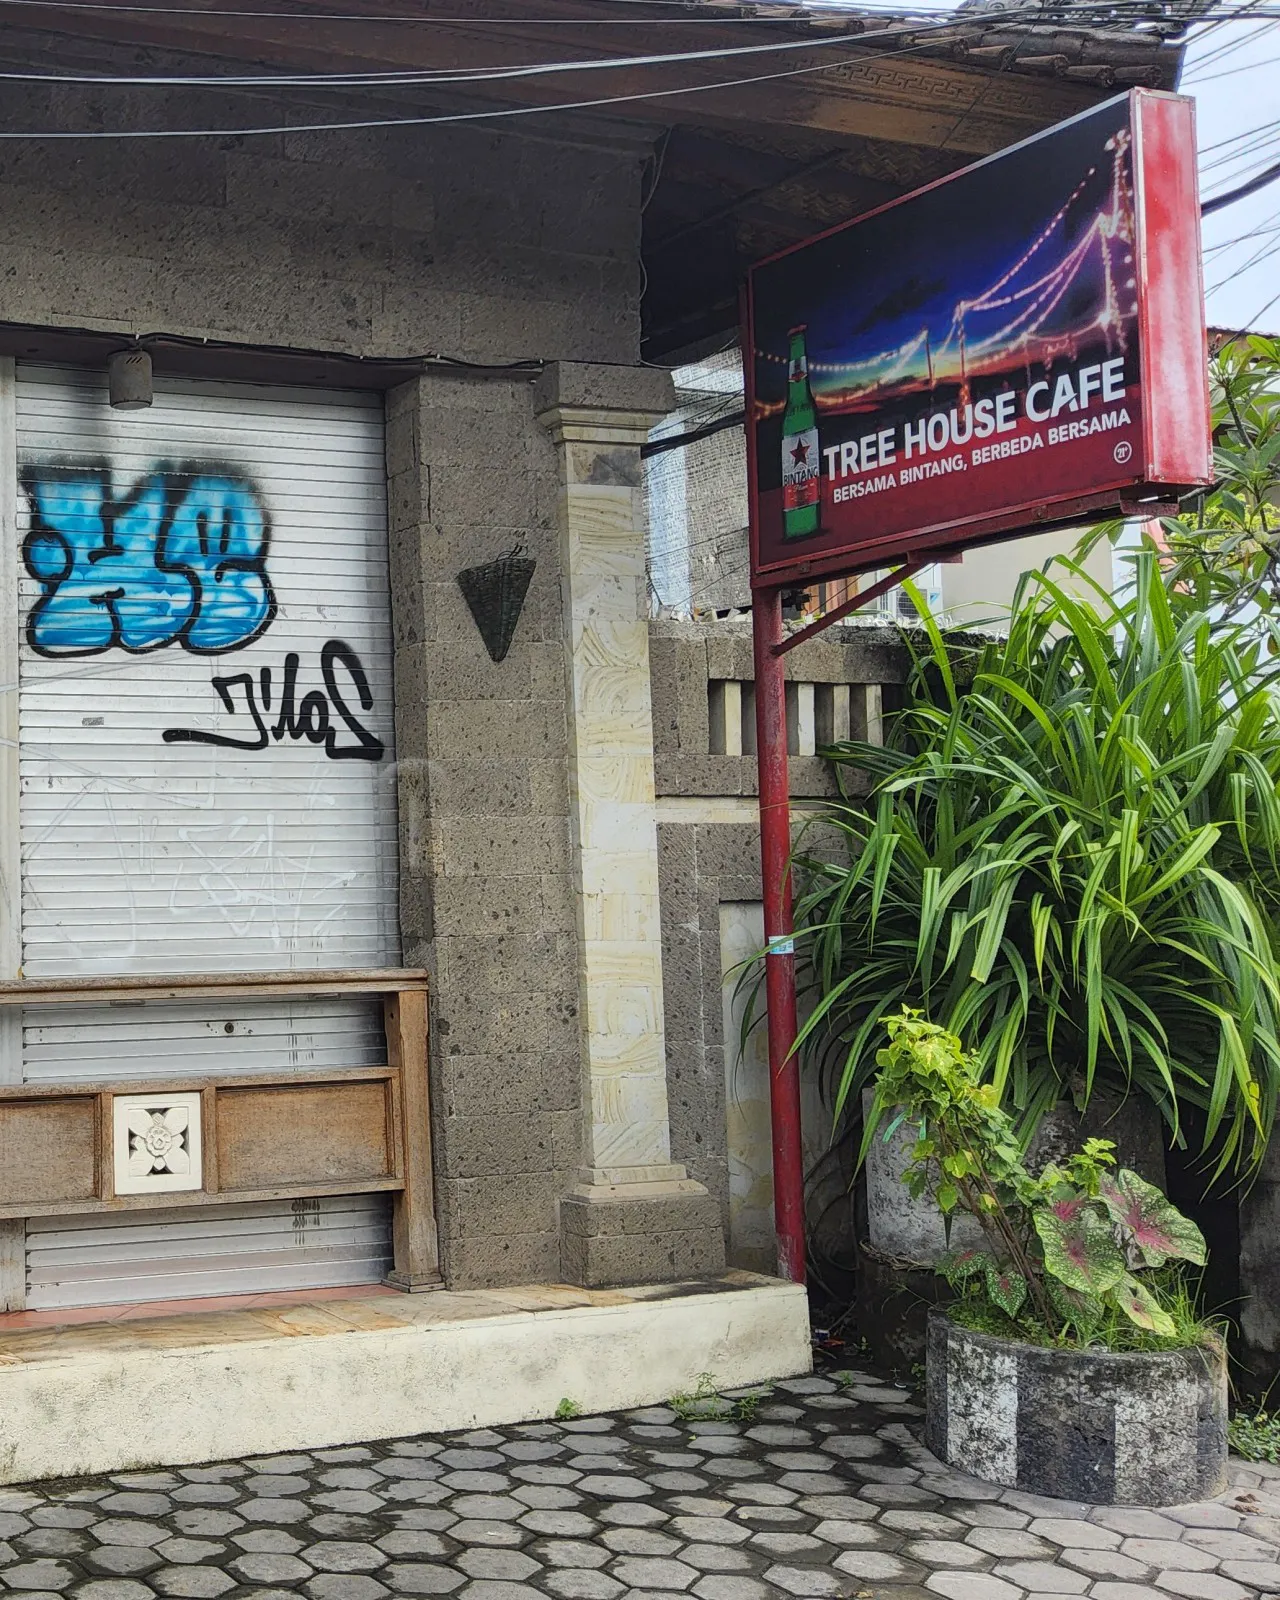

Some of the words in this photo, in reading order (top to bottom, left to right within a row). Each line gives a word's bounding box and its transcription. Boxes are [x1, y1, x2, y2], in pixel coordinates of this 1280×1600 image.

[823, 427, 896, 481] TREE
[904, 390, 1016, 459] HOUSE
[1025, 357, 1126, 422] CAFE
[833, 473, 897, 503] BERSAMA
[900, 454, 967, 485] BINTANG,
[972, 432, 1044, 466] BERBEDA
[1048, 408, 1131, 446] BERSAMA
[783, 466, 818, 486] BINTANG
